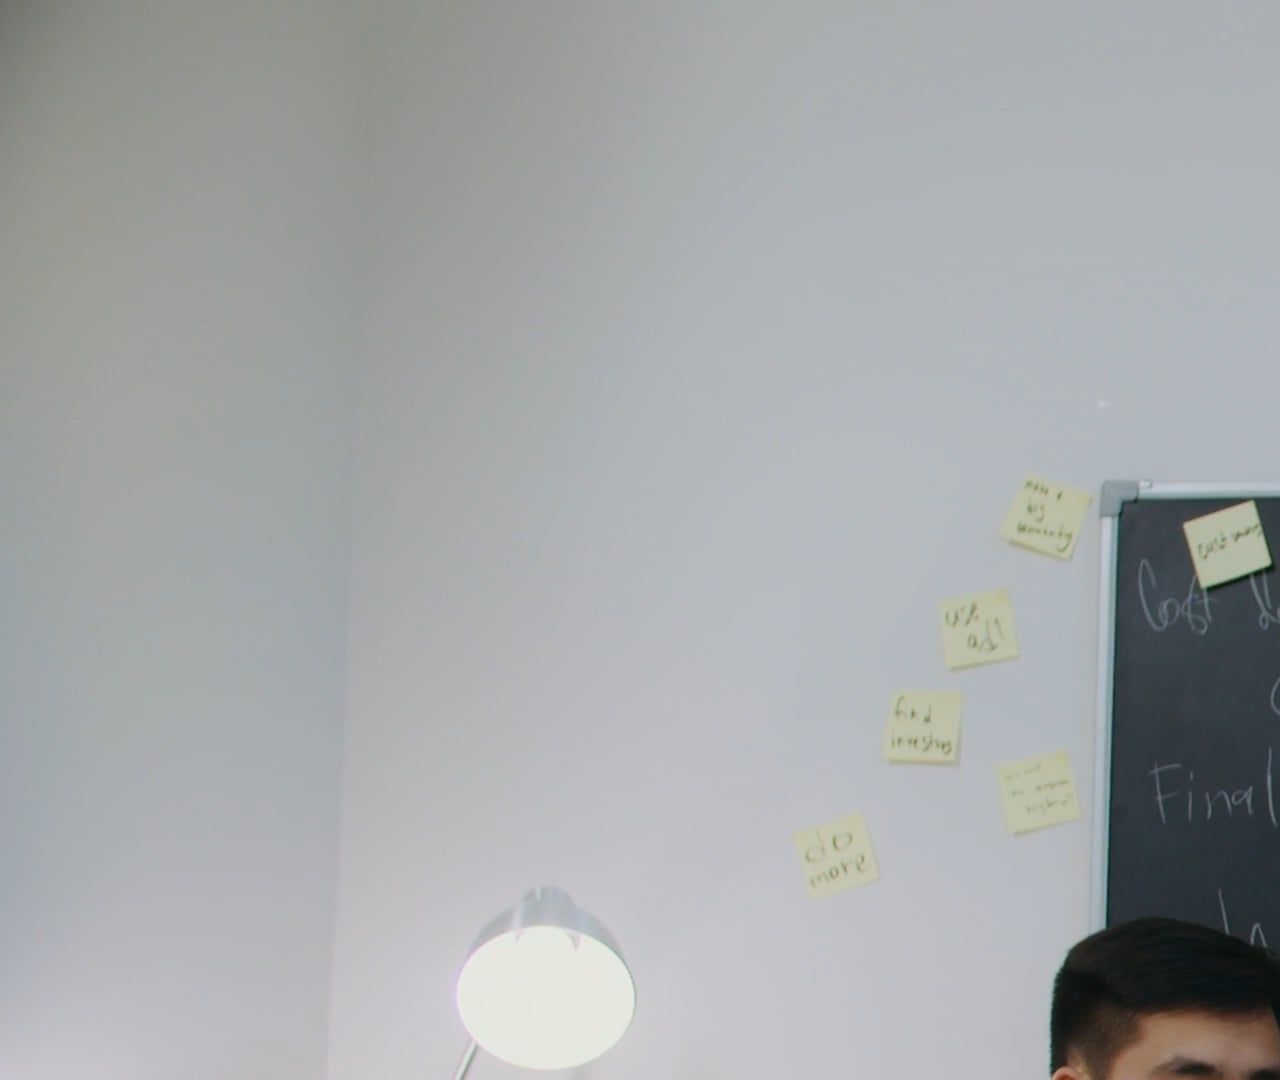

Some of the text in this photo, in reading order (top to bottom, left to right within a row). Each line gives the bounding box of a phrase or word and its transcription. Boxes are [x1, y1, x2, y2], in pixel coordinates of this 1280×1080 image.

[894, 695, 932, 723] find
[1147, 746, 1278, 828] Final
[805, 828, 853, 865] do
